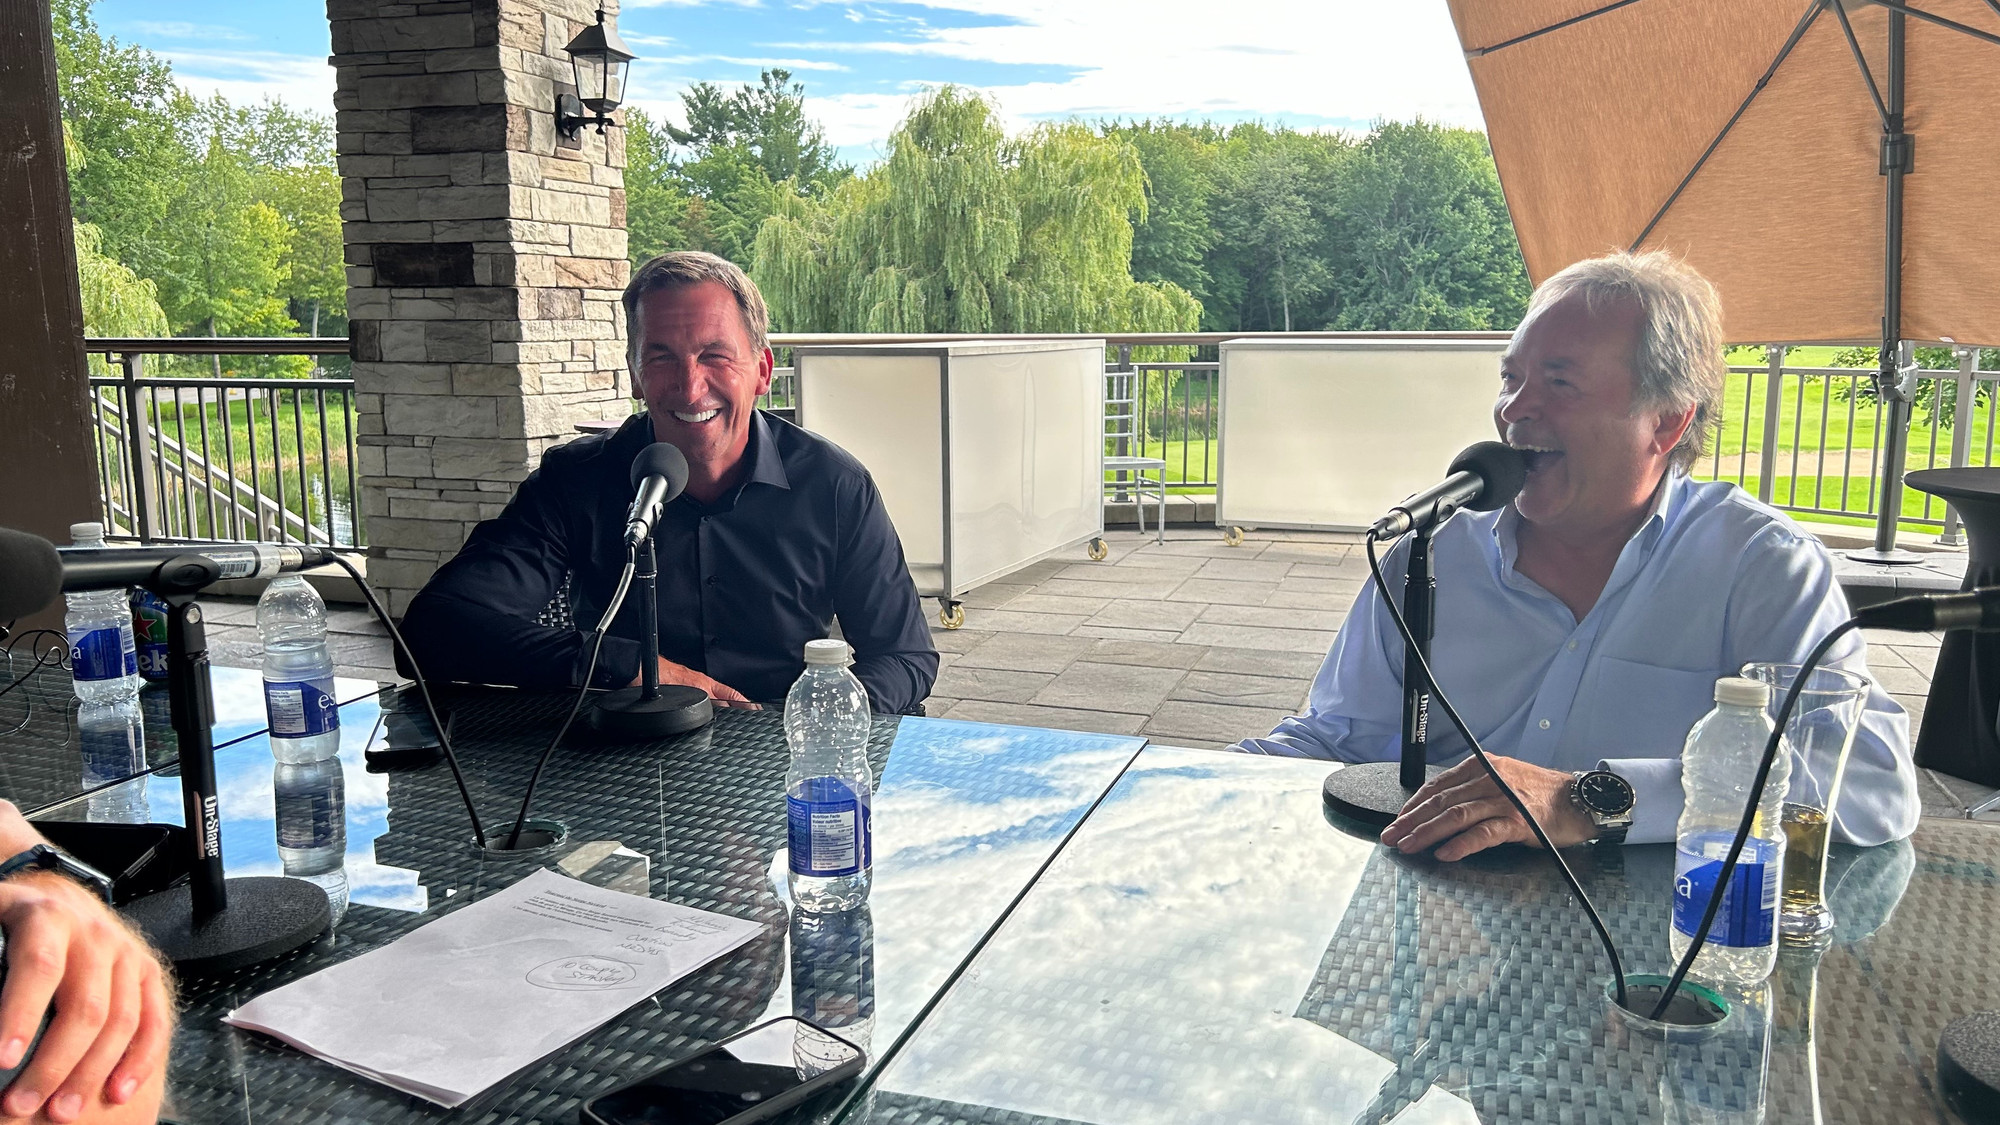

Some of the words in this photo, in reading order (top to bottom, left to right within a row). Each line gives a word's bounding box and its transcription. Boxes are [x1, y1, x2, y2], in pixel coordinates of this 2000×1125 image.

[138, 649, 168, 673] ek
[318, 691, 336, 709] es
[1416, 693, 1429, 744] On-Stage
[204, 794, 219, 857] On-Stage
